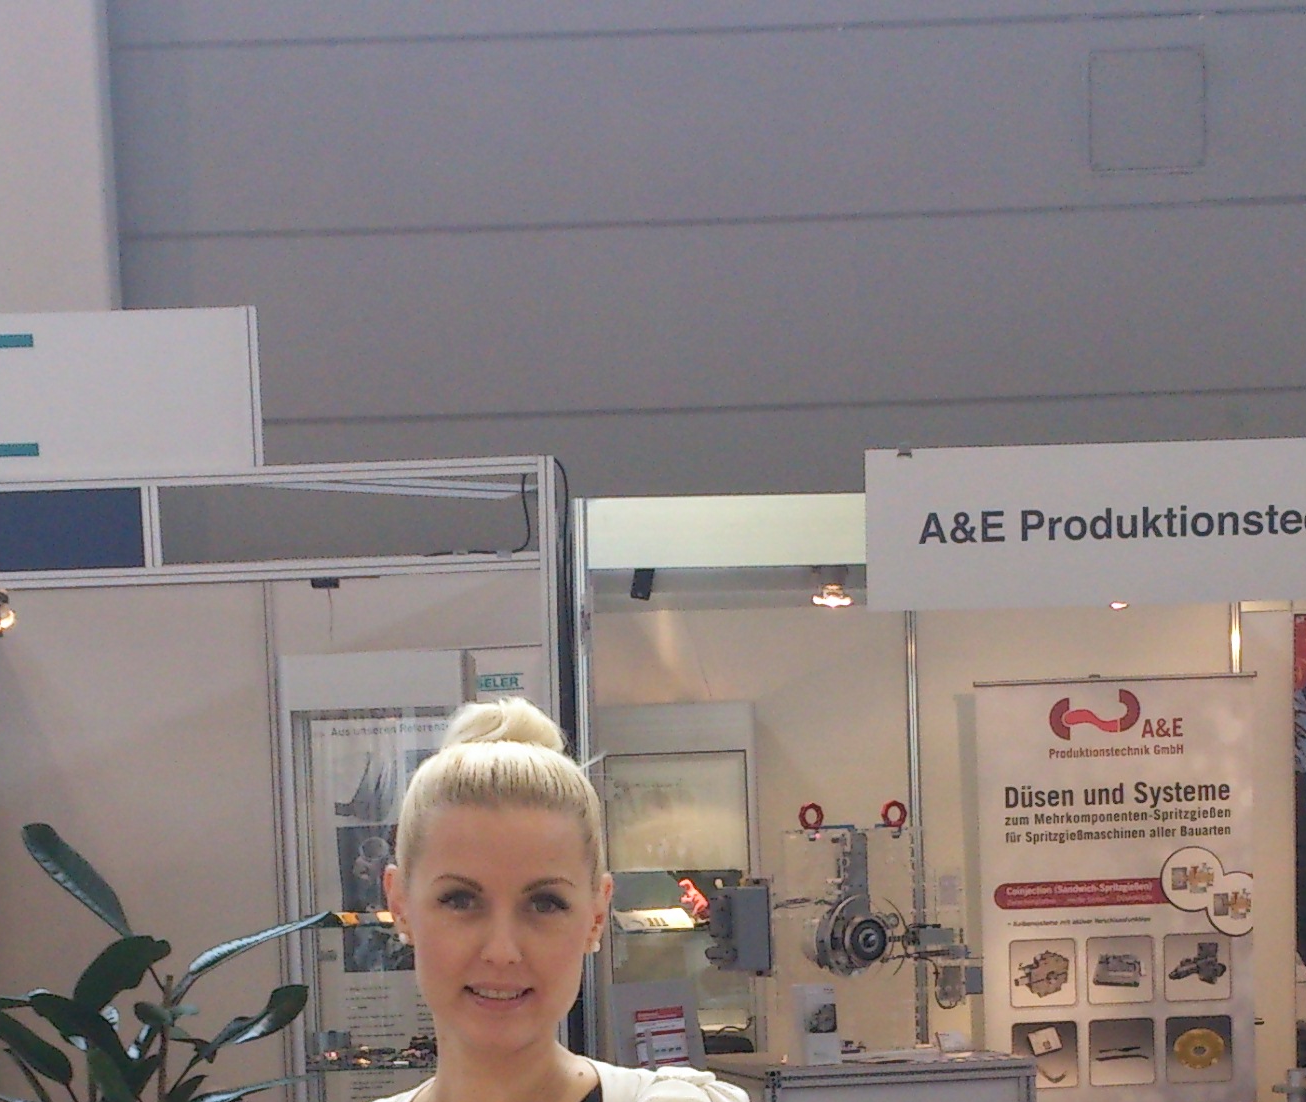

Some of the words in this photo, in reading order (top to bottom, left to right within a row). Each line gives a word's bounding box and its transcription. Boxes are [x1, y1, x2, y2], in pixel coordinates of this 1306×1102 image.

[918, 510, 1005, 544] A&E
[1142, 717, 1184, 738] A&E
[1049, 744, 1151, 759] Produktionstechnik
[1154, 744, 1184, 755] GmbH
[1005, 785, 1074, 809] Düsen
[1084, 783, 1124, 805] und
[1133, 781, 1231, 808] Systeme
[1005, 815, 1030, 826] zum
[1034, 807, 1231, 826] Mehrkomponenten-Spritzgießen
[1005, 831, 1022, 844] für
[1025, 827, 1146, 845] Spritzgießmaschinen
[1149, 825, 1177, 838] aller
[1180, 824, 1231, 837] Bauarten
